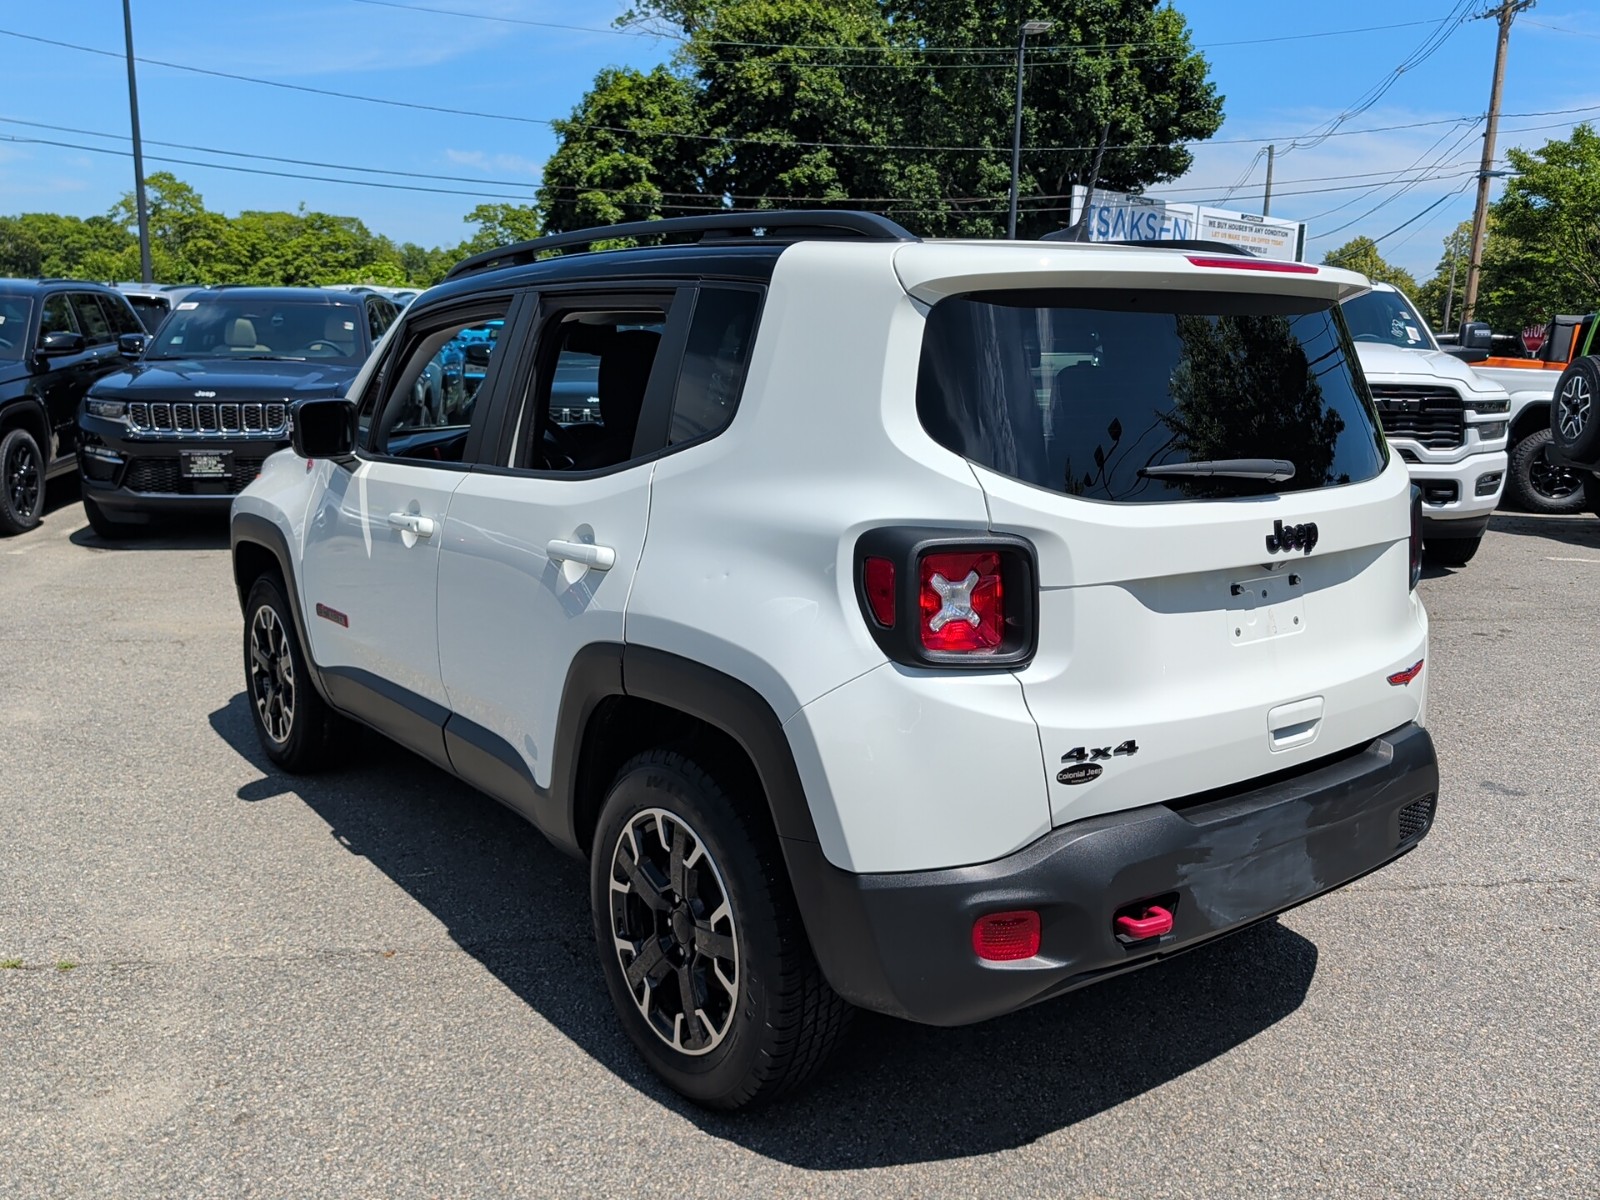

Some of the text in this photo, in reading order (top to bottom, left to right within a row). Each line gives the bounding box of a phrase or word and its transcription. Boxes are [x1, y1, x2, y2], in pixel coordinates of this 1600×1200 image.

[1208, 220, 1216, 228] WE
[1217, 221, 1227, 229] BUY
[1228, 223, 1248, 232] HOUSES
[1254, 226, 1264, 234] ANY
[1264, 228, 1288, 237] CONDITION
[194, 390, 216, 398] Jeep
[1265, 519, 1319, 555] Jeep
[1061, 739, 1139, 764] 4x4
[1057, 770, 1086, 780] Colonial
[1086, 767, 1103, 776] Jeep
